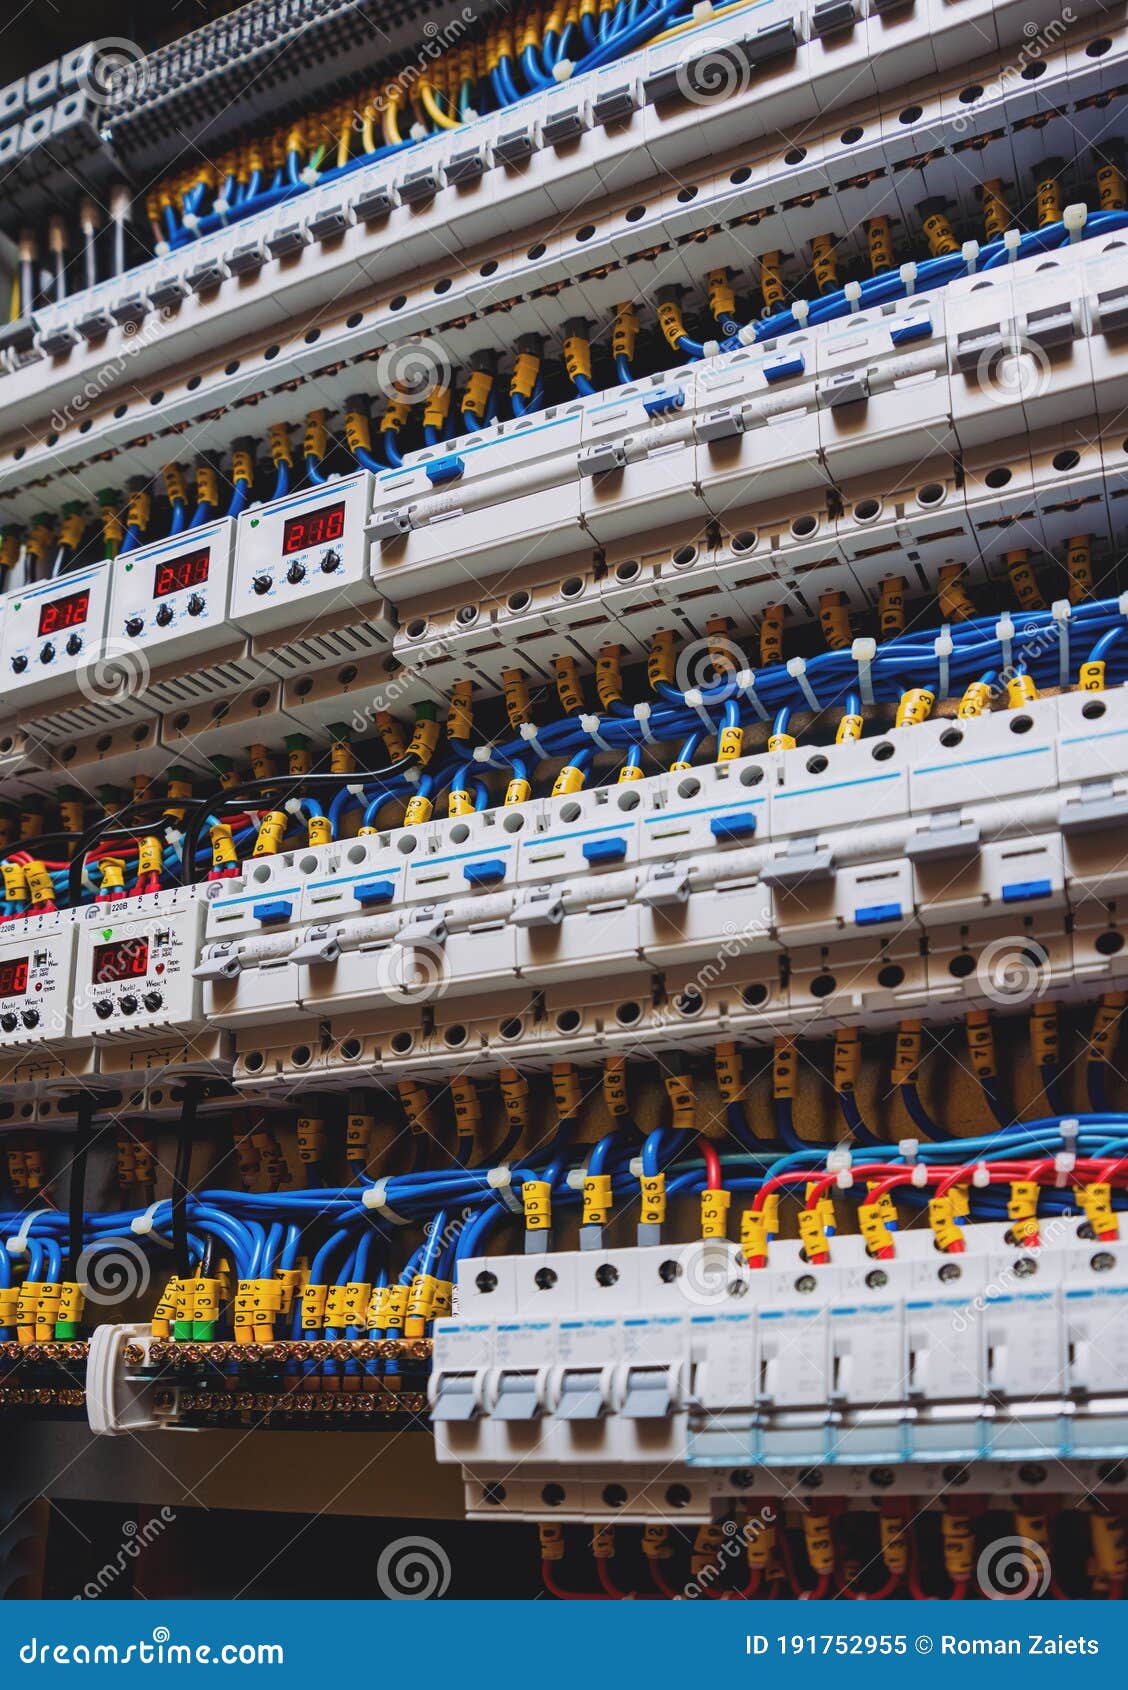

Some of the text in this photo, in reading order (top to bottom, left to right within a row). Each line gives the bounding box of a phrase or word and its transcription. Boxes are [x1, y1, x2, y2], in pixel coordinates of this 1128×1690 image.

[42, 598, 87, 633] 212
[1085, 667, 1099, 690] 50
[723, 733, 741, 754] 52
[450, 795, 466, 814] 42
[256, 815, 273, 851] 025
[609, 1076, 626, 1111] 058
[524, 1183, 540, 1224] 055
[642, 1182, 660, 1221] 055
[702, 1194, 717, 1233] 055
[38, 1286, 52, 1322] 048
[59, 1287, 72, 1319] 023
[177, 1285, 185, 1318] 022
[195, 1284, 211, 1318] 035
[306, 1290, 316, 1326] 045
[324, 1289, 336, 1323] 044
[346, 1288, 358, 1321] 043
